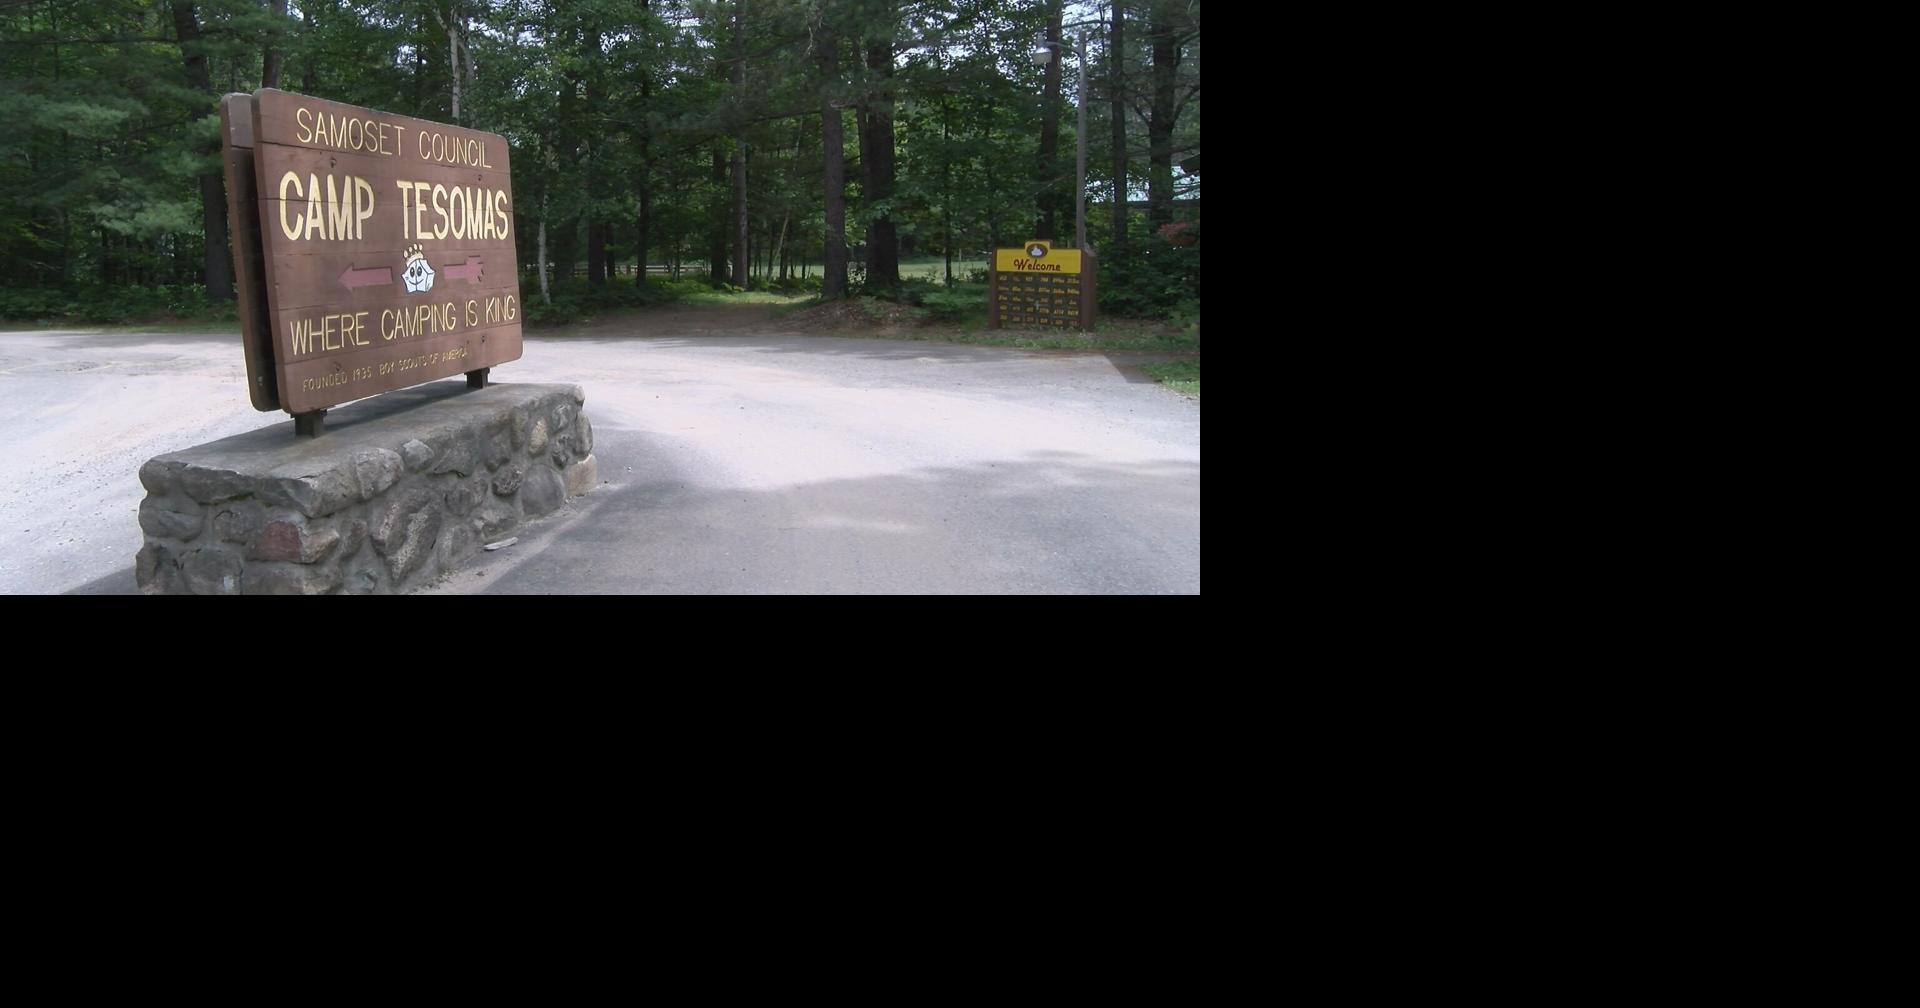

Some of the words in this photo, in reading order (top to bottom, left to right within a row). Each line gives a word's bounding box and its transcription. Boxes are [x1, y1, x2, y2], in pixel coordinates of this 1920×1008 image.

[296, 108, 405, 157] SAMOSET
[418, 130, 492, 169] COUNCIL
[279, 171, 375, 241] CAMP
[396, 180, 509, 241] TESOMAS
[1013, 259, 1061, 272] Welcome
[290, 312, 370, 356] WHERE
[381, 302, 456, 341] CAMPING
[465, 299, 478, 328] IS
[485, 295, 516, 322] KING
[303, 371, 348, 393] FOUNDED
[352, 366, 372, 382] 1935
[379, 361, 396, 376] BOY
[399, 355, 427, 372] SCOUTS
[429, 352, 439, 365] OF
